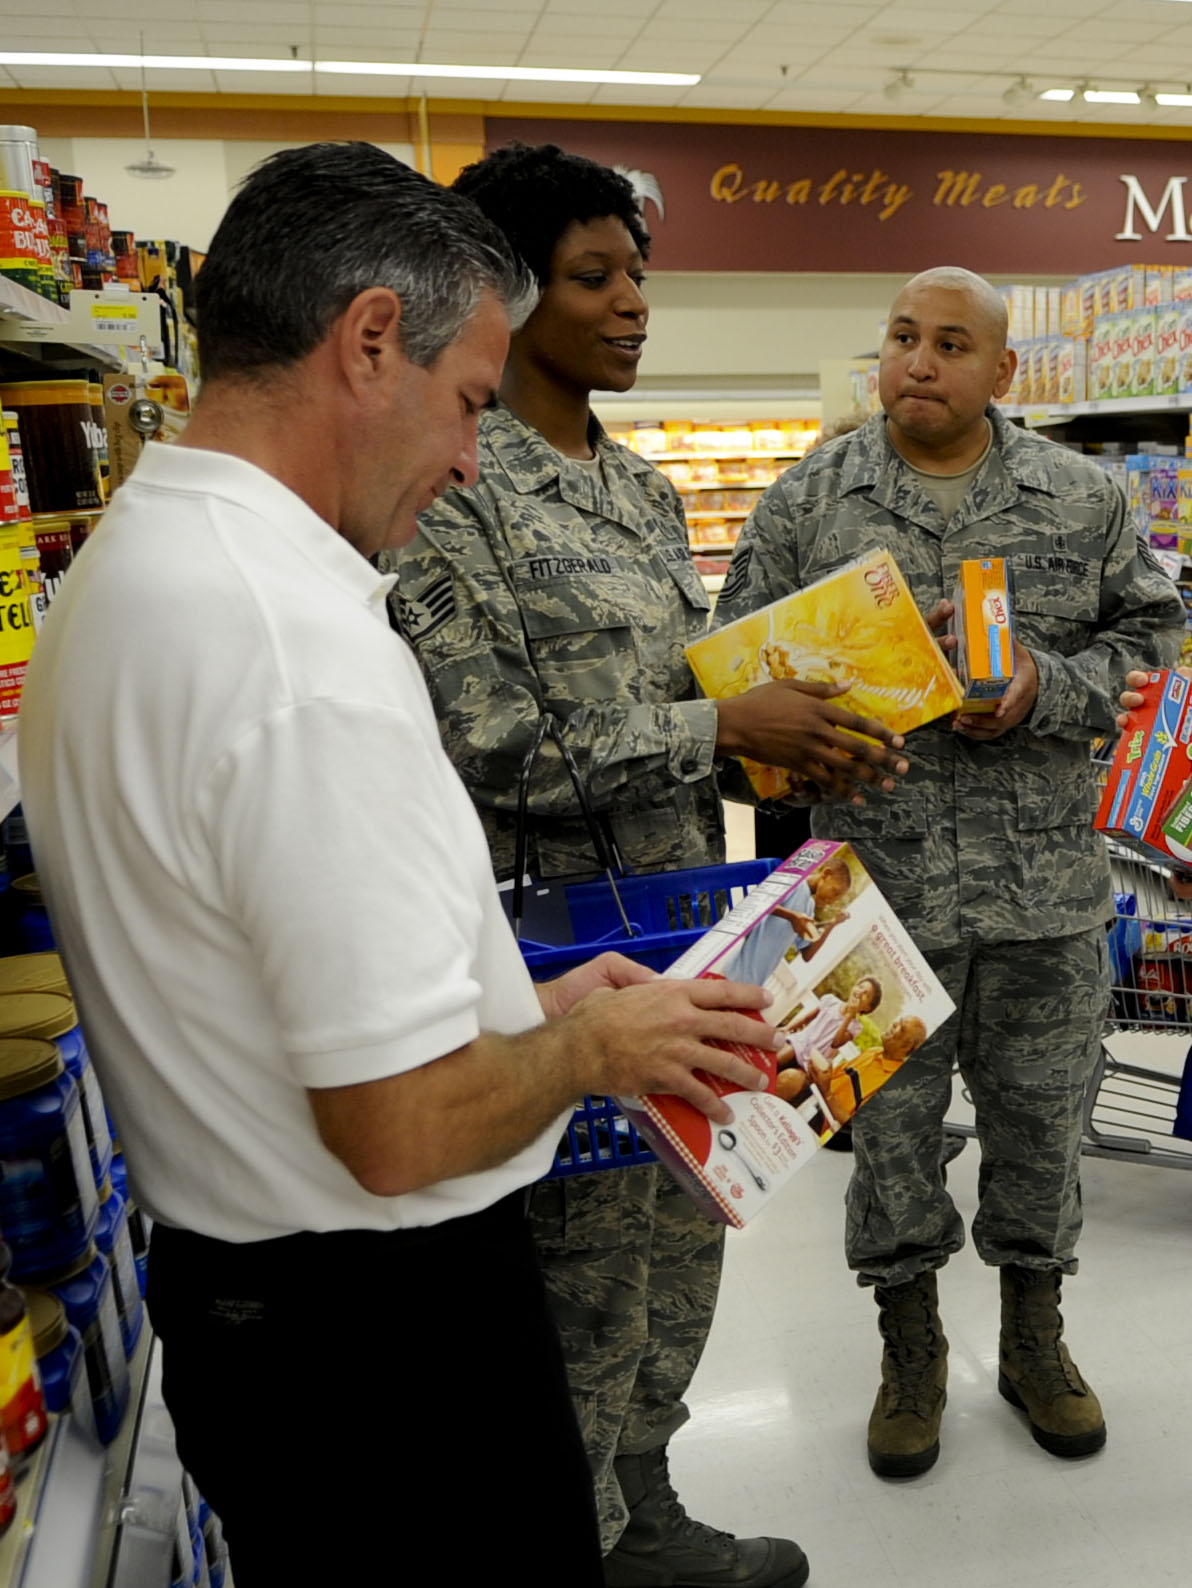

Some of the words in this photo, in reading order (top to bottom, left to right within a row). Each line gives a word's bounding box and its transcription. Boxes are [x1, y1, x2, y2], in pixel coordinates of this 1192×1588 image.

[710, 163, 914, 221] Quality
[932, 169, 1085, 209] Meats
[529, 557, 612, 580] FITZGERALD
[1025, 554, 1046, 570] U.S.
[1049, 556, 1065, 573] AIR
[1066, 558, 1089, 577] FORCE
[1127, 730, 1145, 763] Trix
